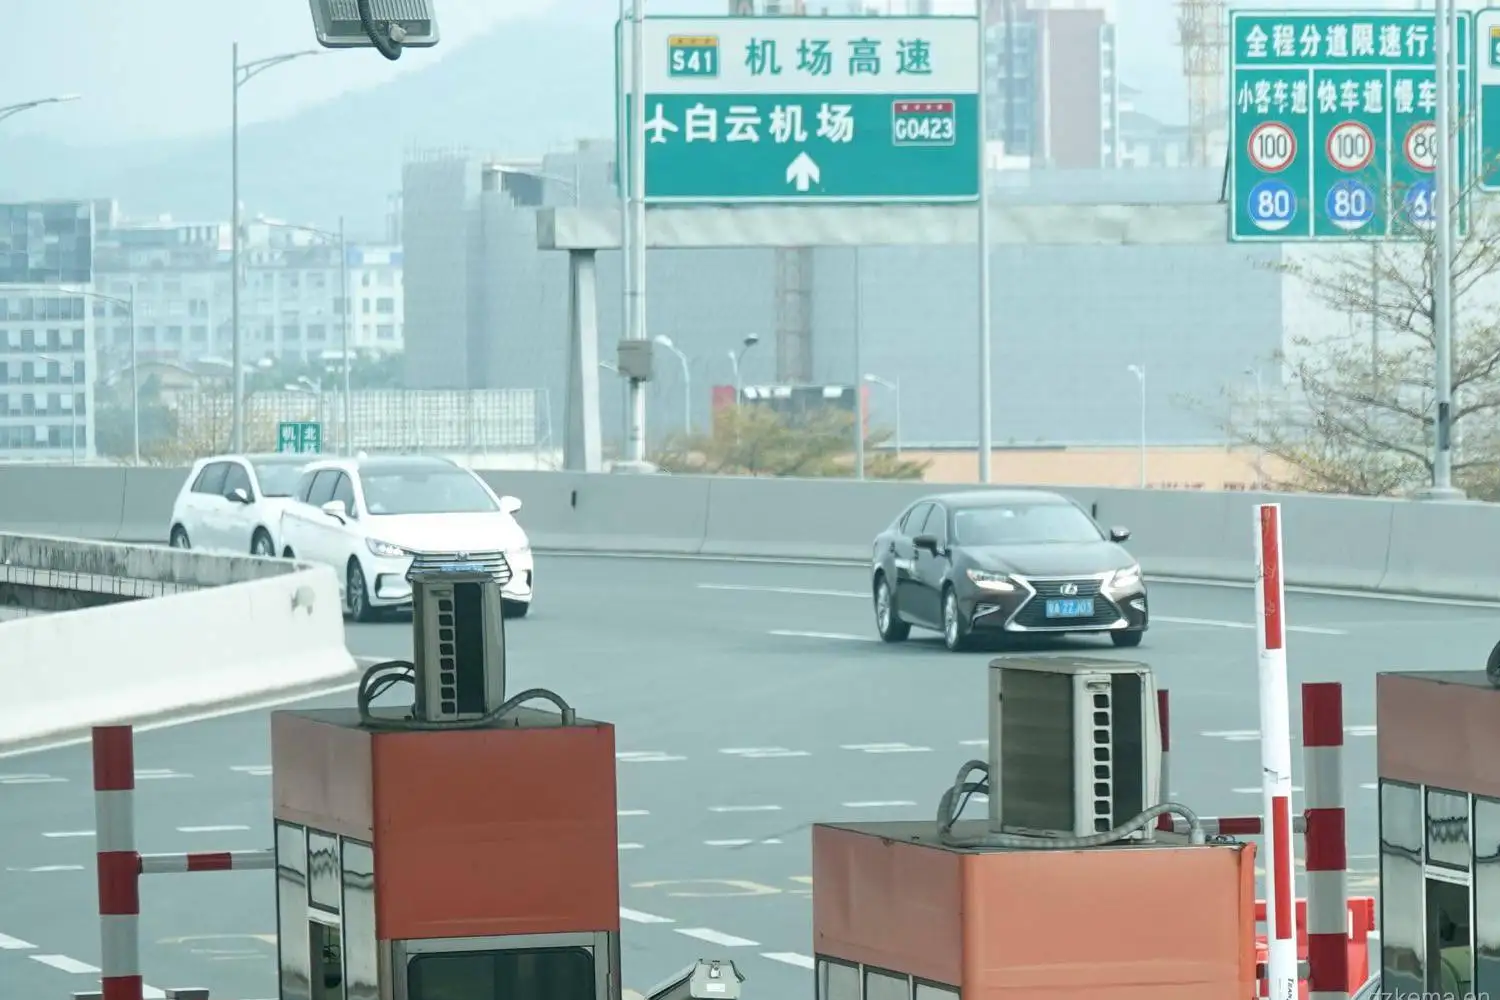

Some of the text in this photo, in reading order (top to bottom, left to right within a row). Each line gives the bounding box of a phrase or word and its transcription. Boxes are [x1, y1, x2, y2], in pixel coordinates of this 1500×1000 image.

[1245, 23, 1438, 58] 全程分道限速行
[672, 50, 713, 72] S41
[744, 37, 933, 77] 机场高速
[1237, 79, 1309, 115] 小客车道
[1316, 79, 1384, 114] 快车道
[1393, 78, 1440, 114] 慢车
[685, 103, 855, 144] 白云机场
[895, 118, 954, 140] G0423
[1257, 133, 1288, 160] 100
[1337, 133, 1366, 160] 100
[1257, 189, 1290, 218] 80
[1334, 189, 1366, 217] 80
